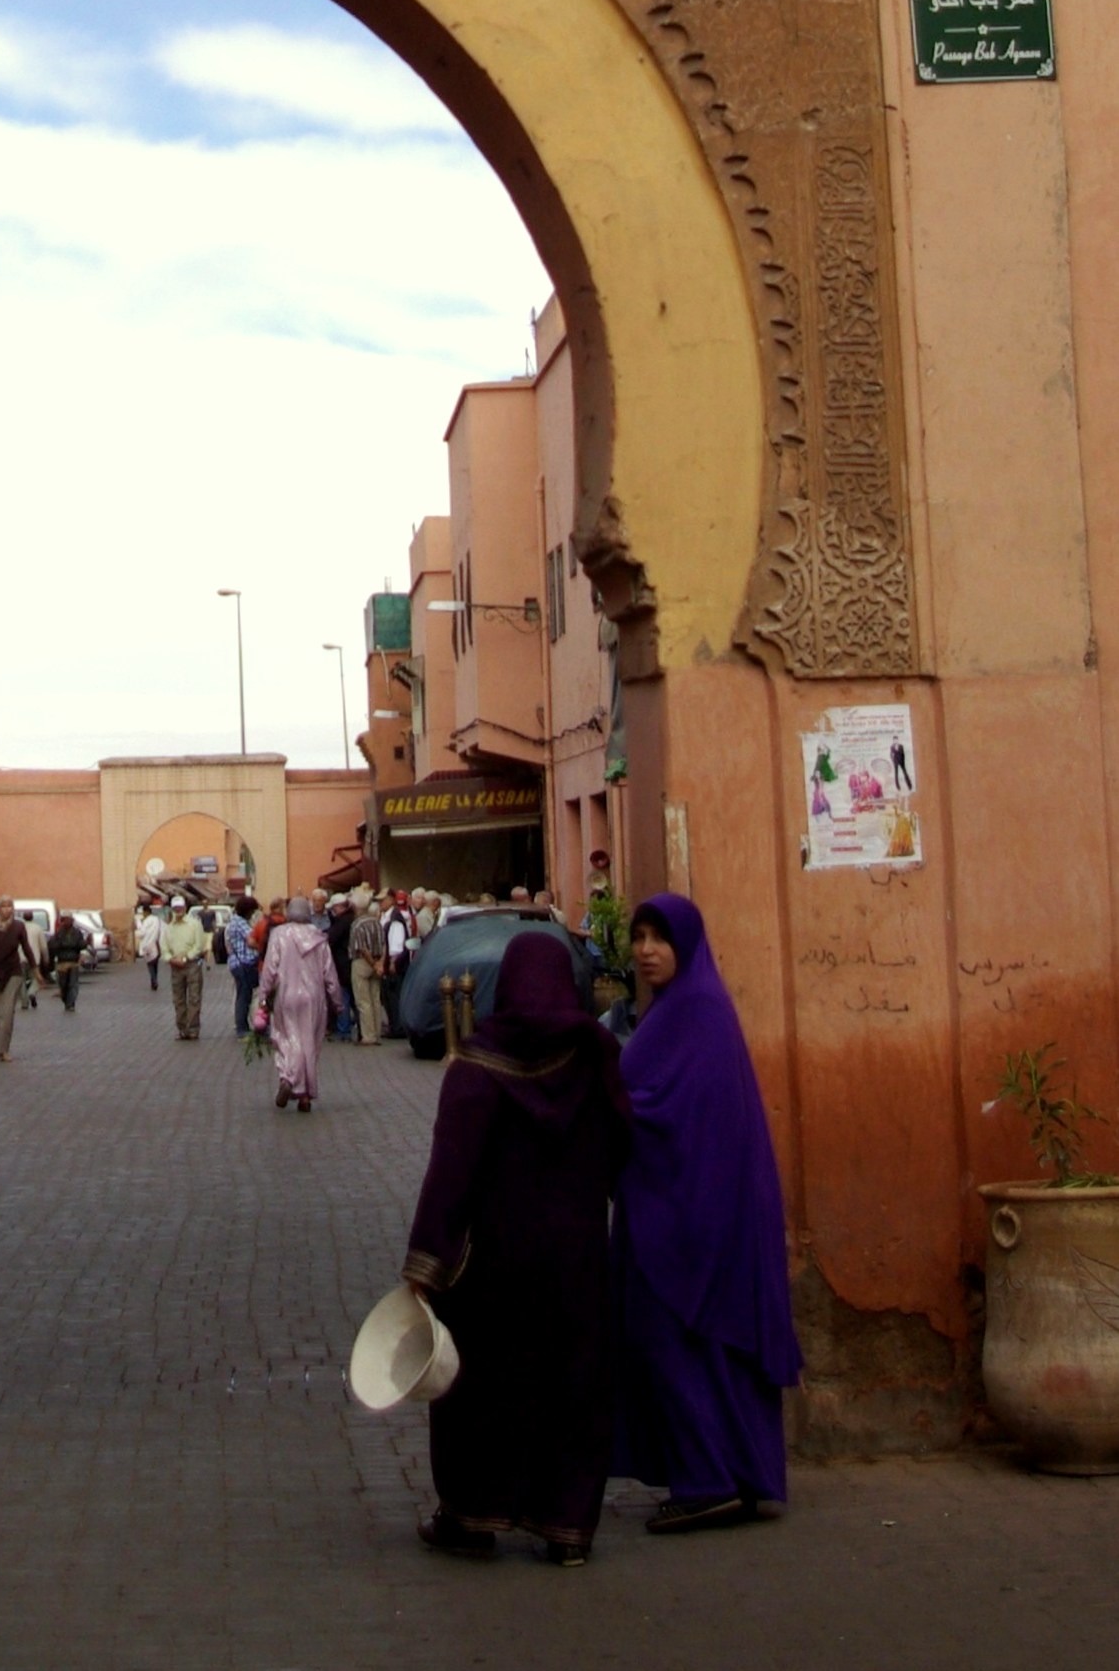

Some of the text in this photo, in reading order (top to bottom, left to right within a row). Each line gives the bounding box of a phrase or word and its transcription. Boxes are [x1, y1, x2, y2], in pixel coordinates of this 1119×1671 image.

[933, 41, 972, 66] Passage
[973, 40, 996, 61] Bab
[385, 794, 453, 815] GALERIE
[474, 790, 537, 808] KASBAH
